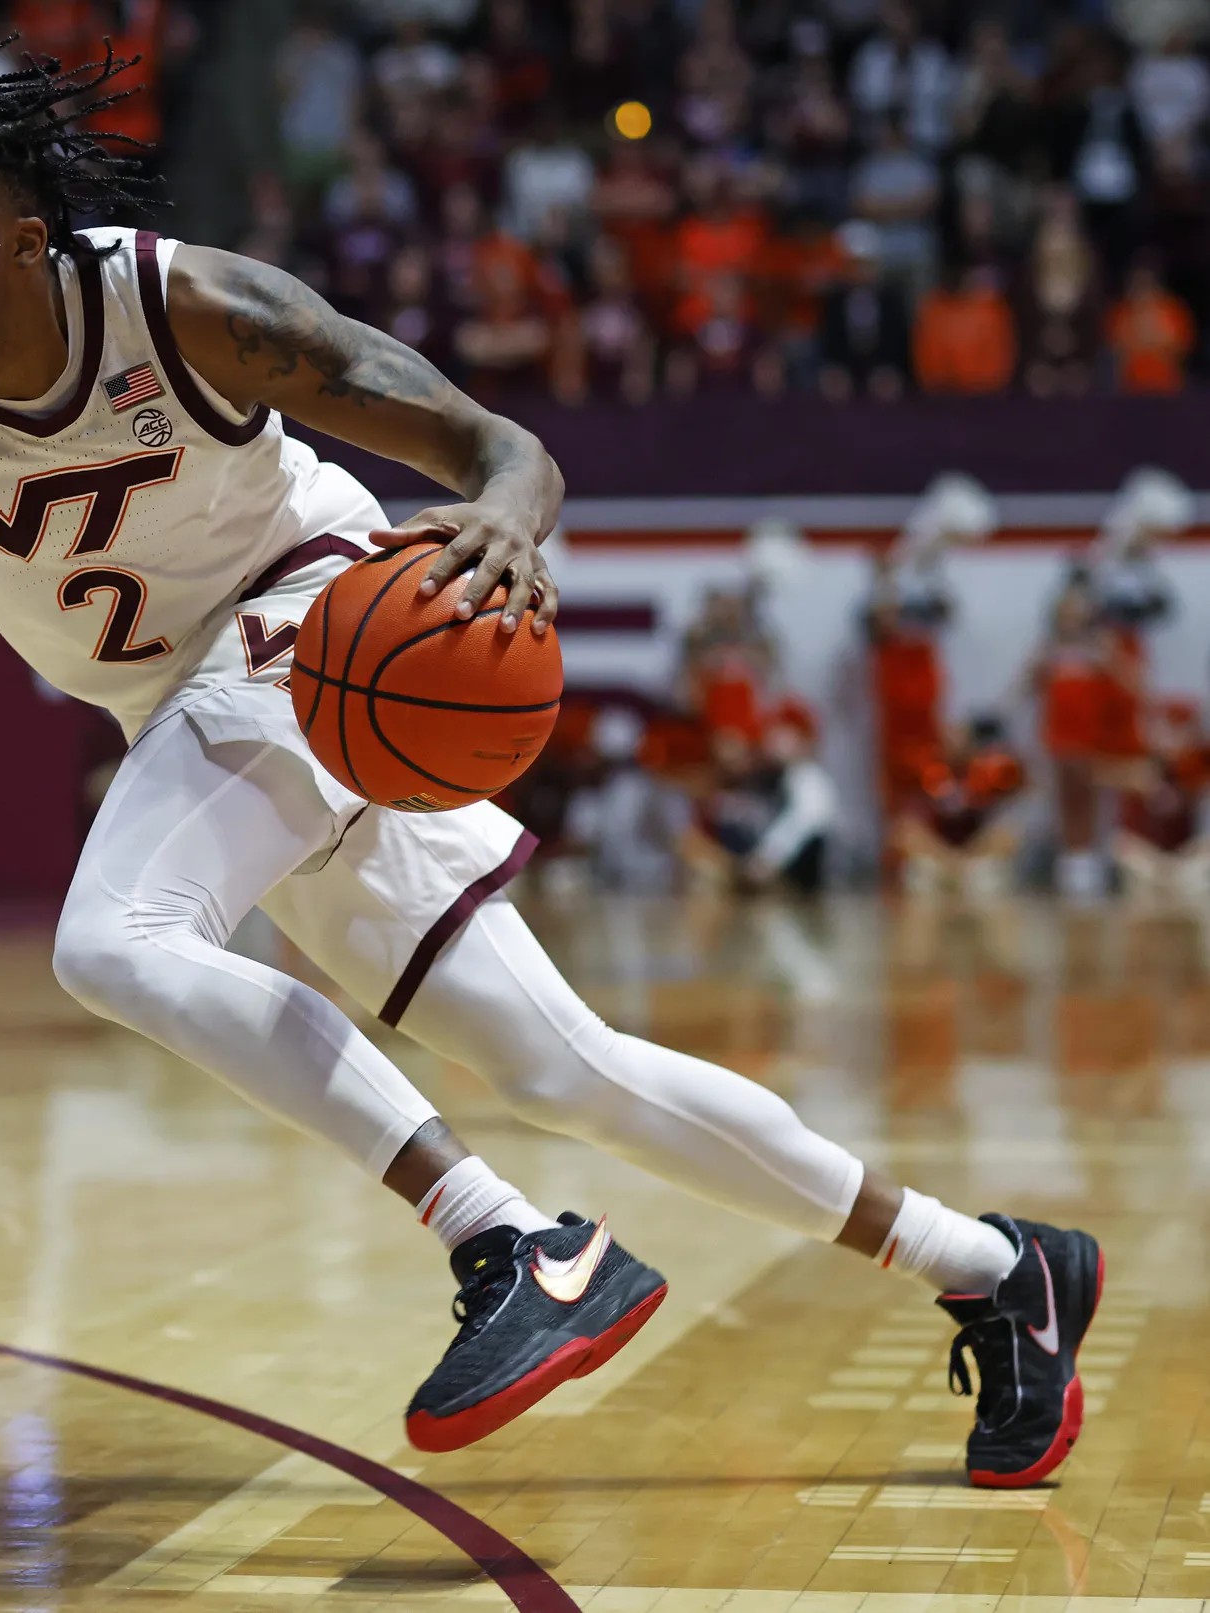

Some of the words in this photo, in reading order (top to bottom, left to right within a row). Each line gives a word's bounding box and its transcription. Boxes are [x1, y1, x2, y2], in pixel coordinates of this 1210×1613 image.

[139, 416, 168, 434] ACC
[57, 566, 174, 664] 2
[235, 611, 301, 694] V
